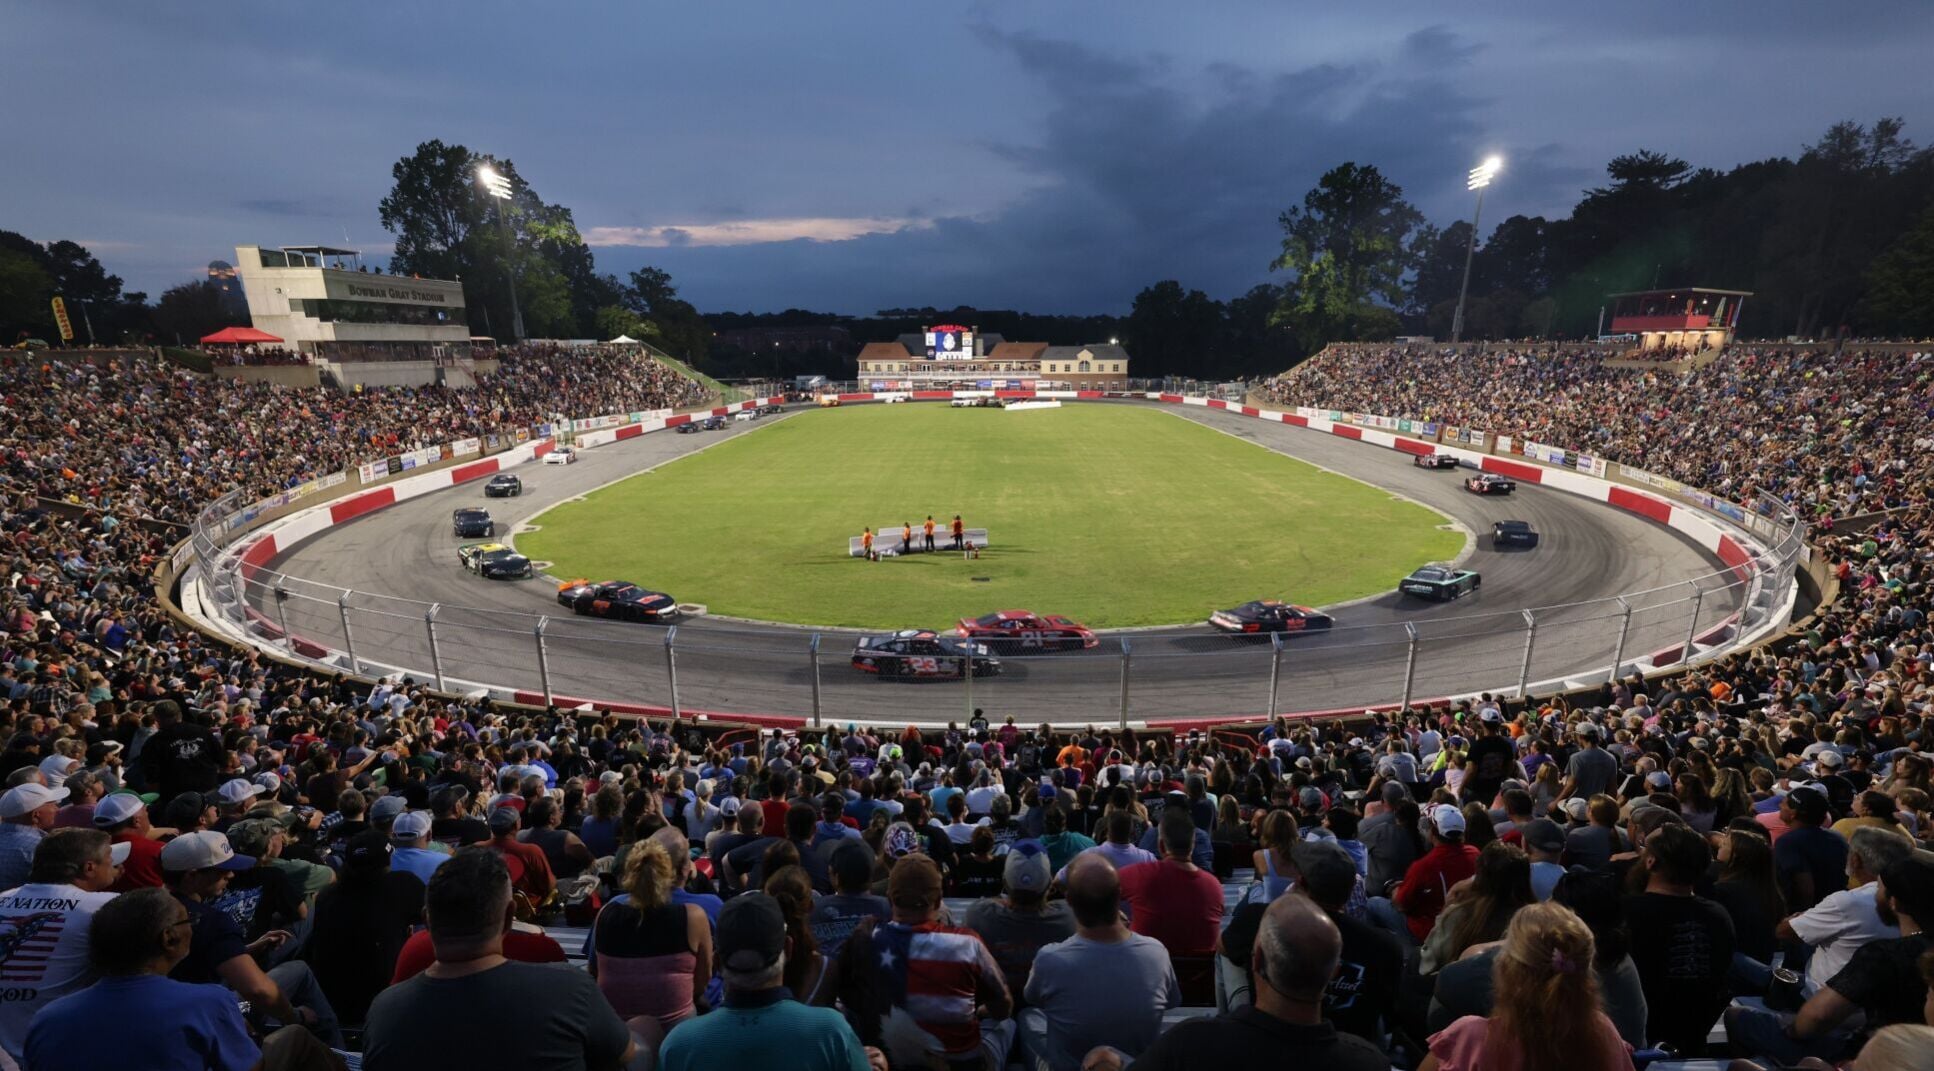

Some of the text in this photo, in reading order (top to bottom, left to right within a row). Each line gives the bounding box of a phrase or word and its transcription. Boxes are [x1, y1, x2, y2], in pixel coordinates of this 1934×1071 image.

[388, 287, 410, 300] GRAY
[412, 290, 445, 303] STADIUM
[10, 897, 80, 911] NATION
